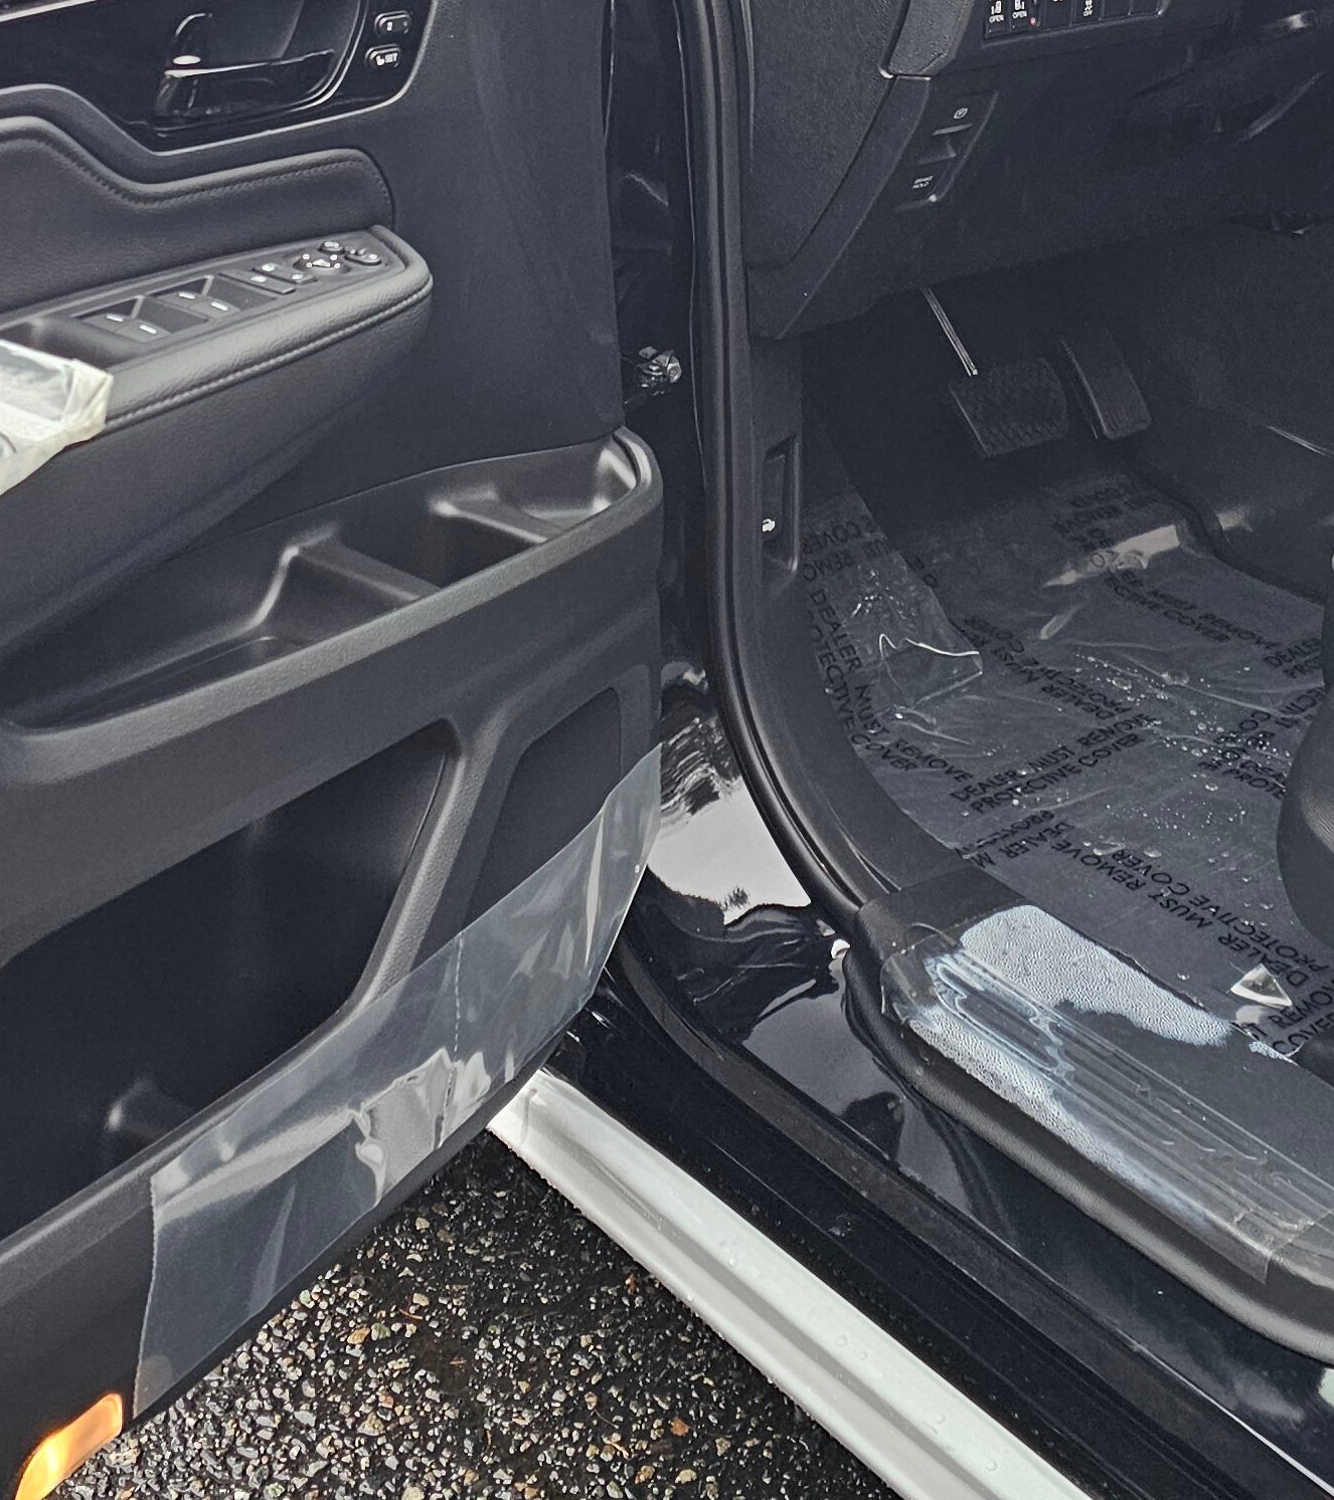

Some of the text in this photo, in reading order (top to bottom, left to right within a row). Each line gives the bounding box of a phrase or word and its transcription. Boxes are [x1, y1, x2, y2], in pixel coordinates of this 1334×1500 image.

[811, 589, 862, 671] DEALER
[1051, 840, 1309, 988] DEALER MUST REMOVE
[1111, 848, 1330, 973] PROTECTIVE COVER
